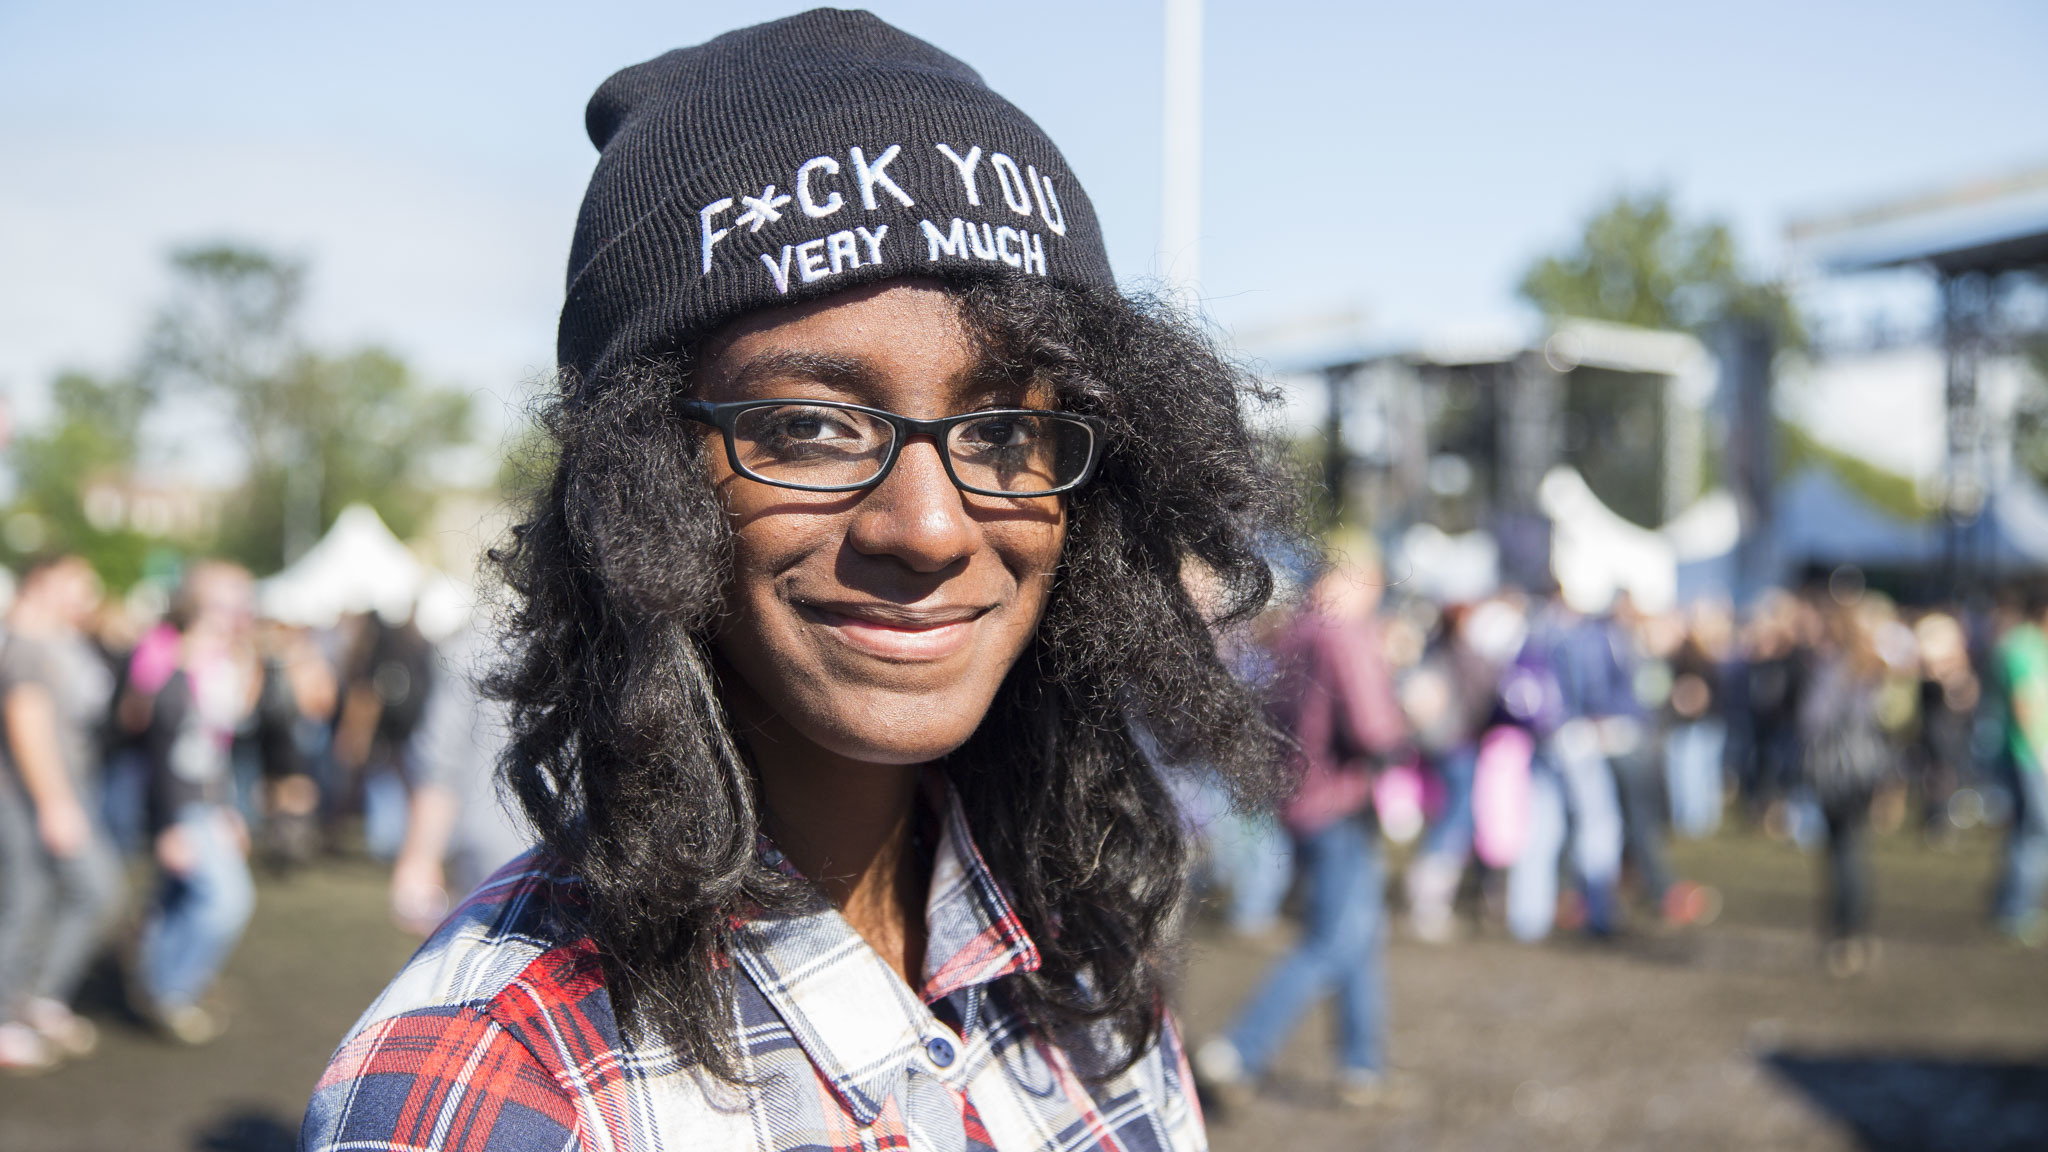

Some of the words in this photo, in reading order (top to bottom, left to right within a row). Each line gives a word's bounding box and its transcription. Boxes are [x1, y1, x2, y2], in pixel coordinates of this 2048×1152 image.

[936, 143, 1066, 236] YOU
[760, 224, 888, 294] VERY
[920, 218, 1046, 276] MUCH
